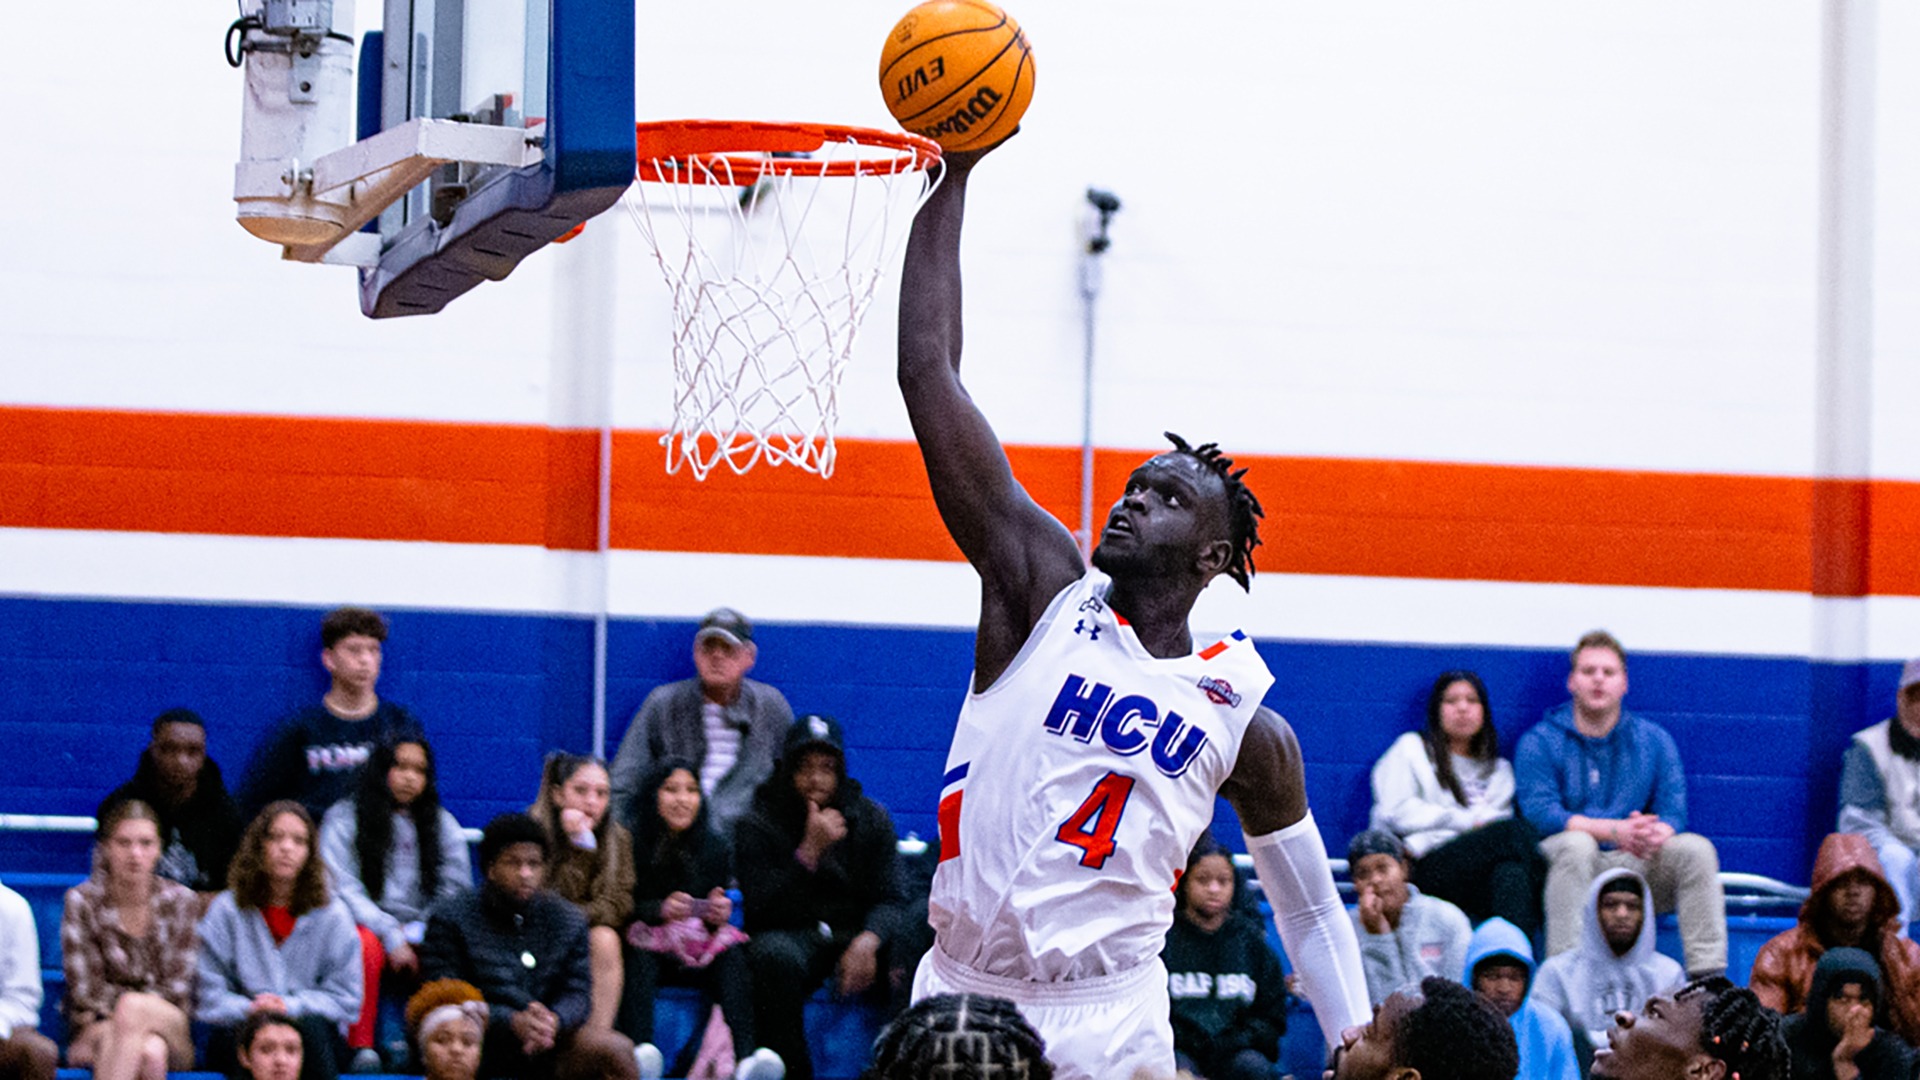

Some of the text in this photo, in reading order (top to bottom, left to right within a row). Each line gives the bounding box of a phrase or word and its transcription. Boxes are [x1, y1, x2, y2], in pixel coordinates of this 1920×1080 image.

[898, 56, 945, 101] EVO
[1043, 673, 1208, 779] HCU
[1055, 771, 1136, 870] 4
